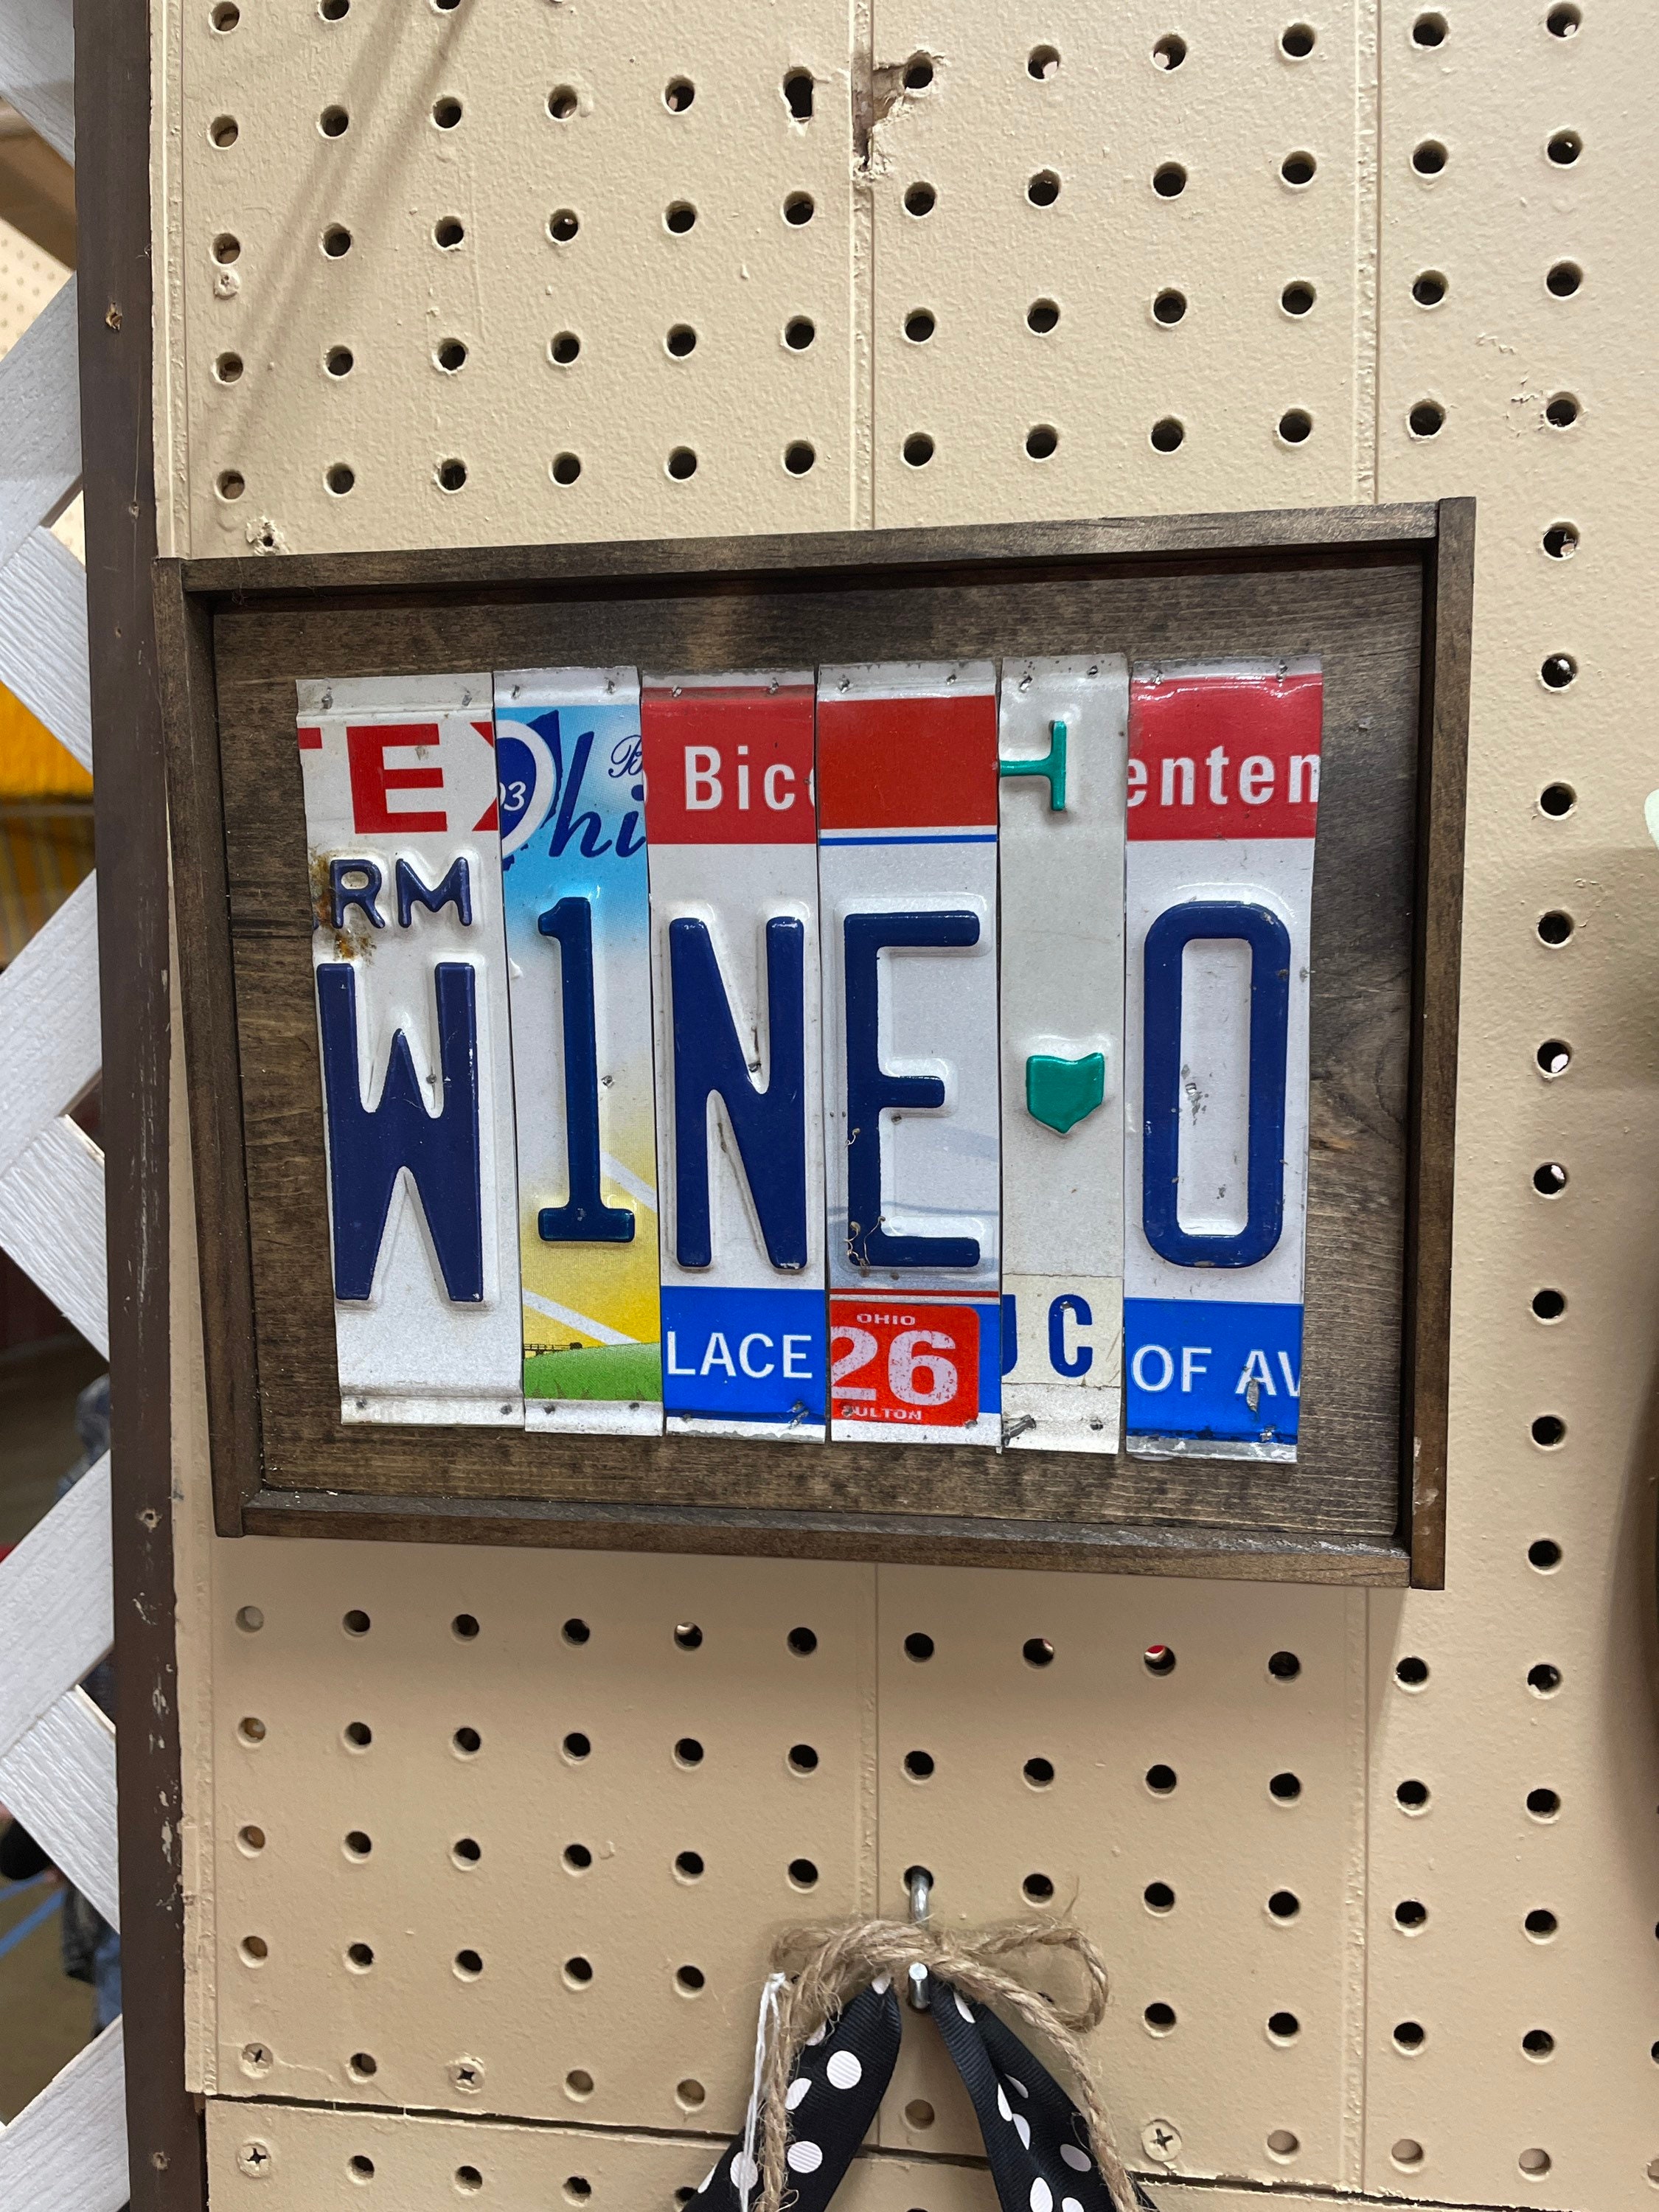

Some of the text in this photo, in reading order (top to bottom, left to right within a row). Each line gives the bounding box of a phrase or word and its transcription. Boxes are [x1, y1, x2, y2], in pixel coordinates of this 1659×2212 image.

[499, 781, 526, 811] 3
[685, 745, 815, 810] Bic
[313, 856, 473, 929] RM
[856, 1313, 916, 1326] OHIO
[667, 1332, 813, 1380] LACE
[830, 1326, 958, 1406] 26
[1132, 1344, 1213, 1394] OF
